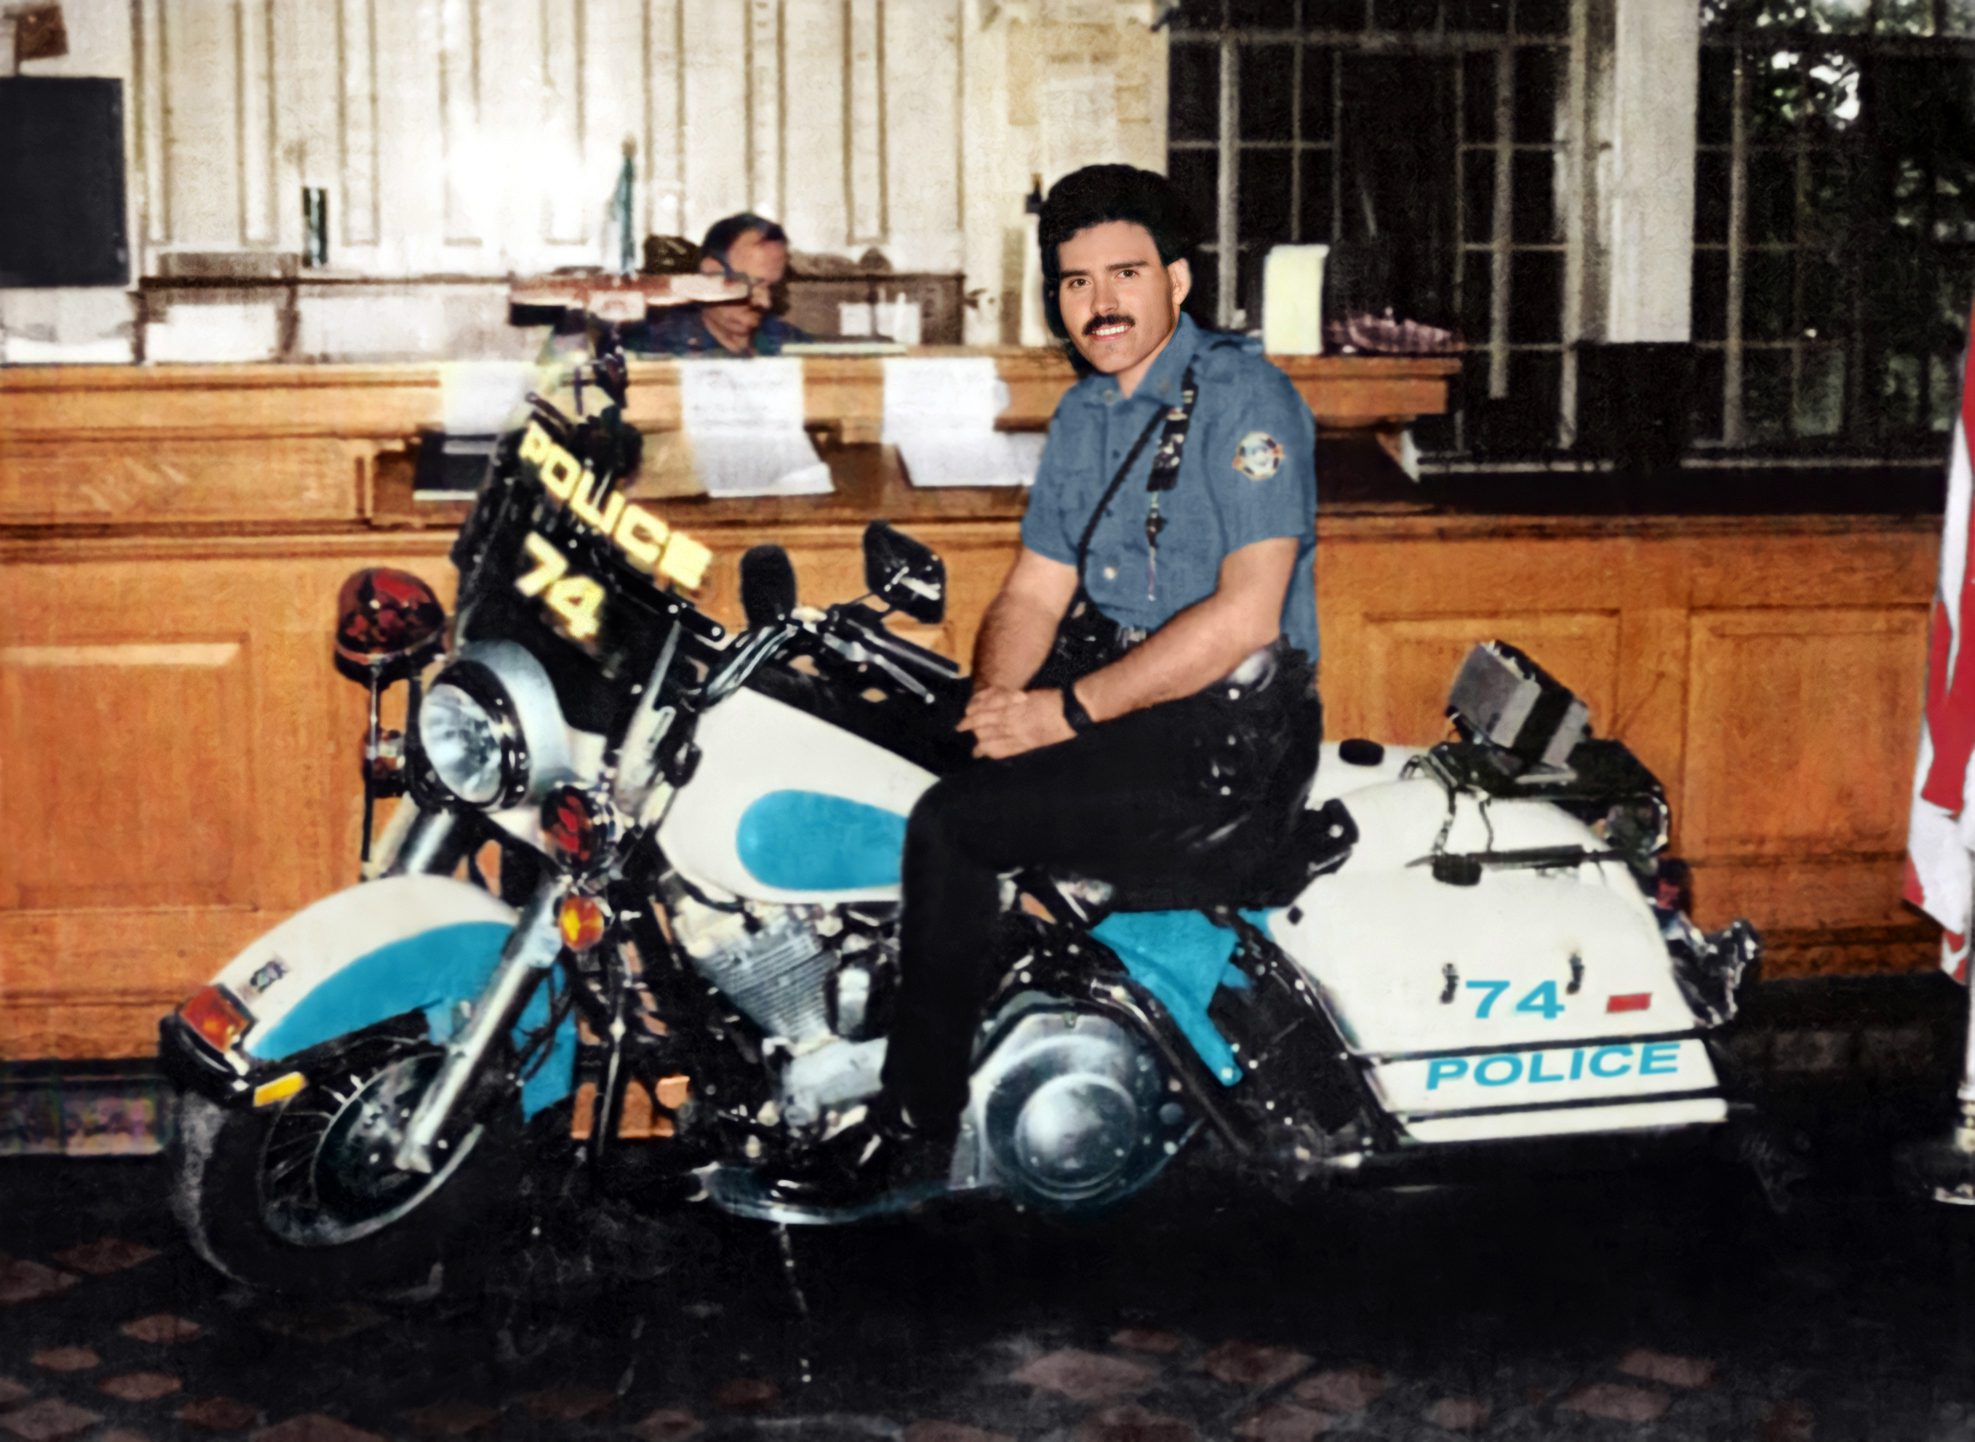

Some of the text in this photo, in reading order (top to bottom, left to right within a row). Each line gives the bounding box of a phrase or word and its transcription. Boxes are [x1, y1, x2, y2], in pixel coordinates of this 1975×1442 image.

[514, 531, 606, 639] 74
[1466, 980, 1565, 1020] 74
[1426, 1043, 1681, 1091] POLICE
